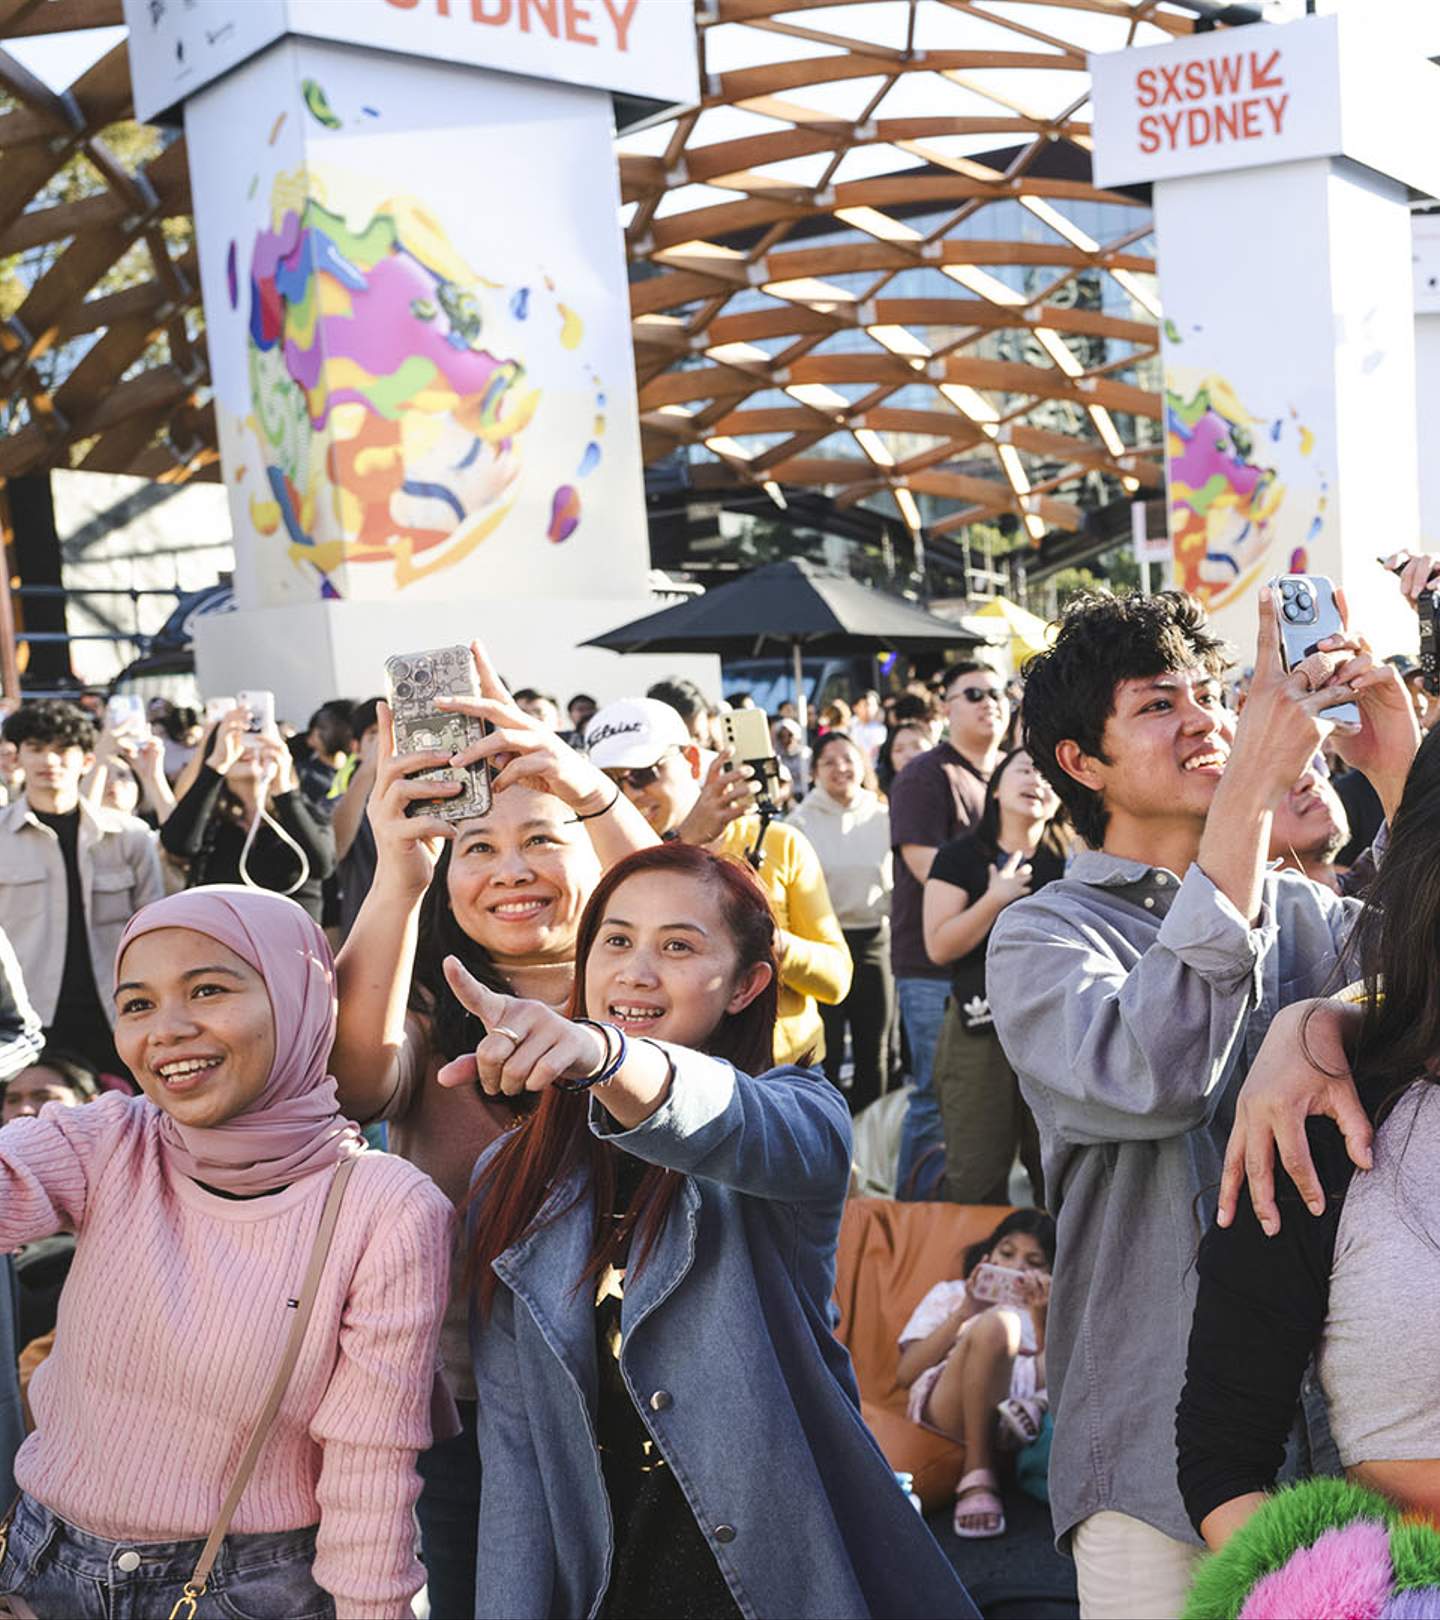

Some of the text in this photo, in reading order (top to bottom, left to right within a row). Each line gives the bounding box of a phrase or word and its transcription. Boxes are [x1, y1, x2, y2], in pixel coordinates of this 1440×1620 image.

[384, 0, 639, 52] NEY
[1136, 54, 1242, 107] SXSW
[1139, 94, 1289, 154] SYDNEY
